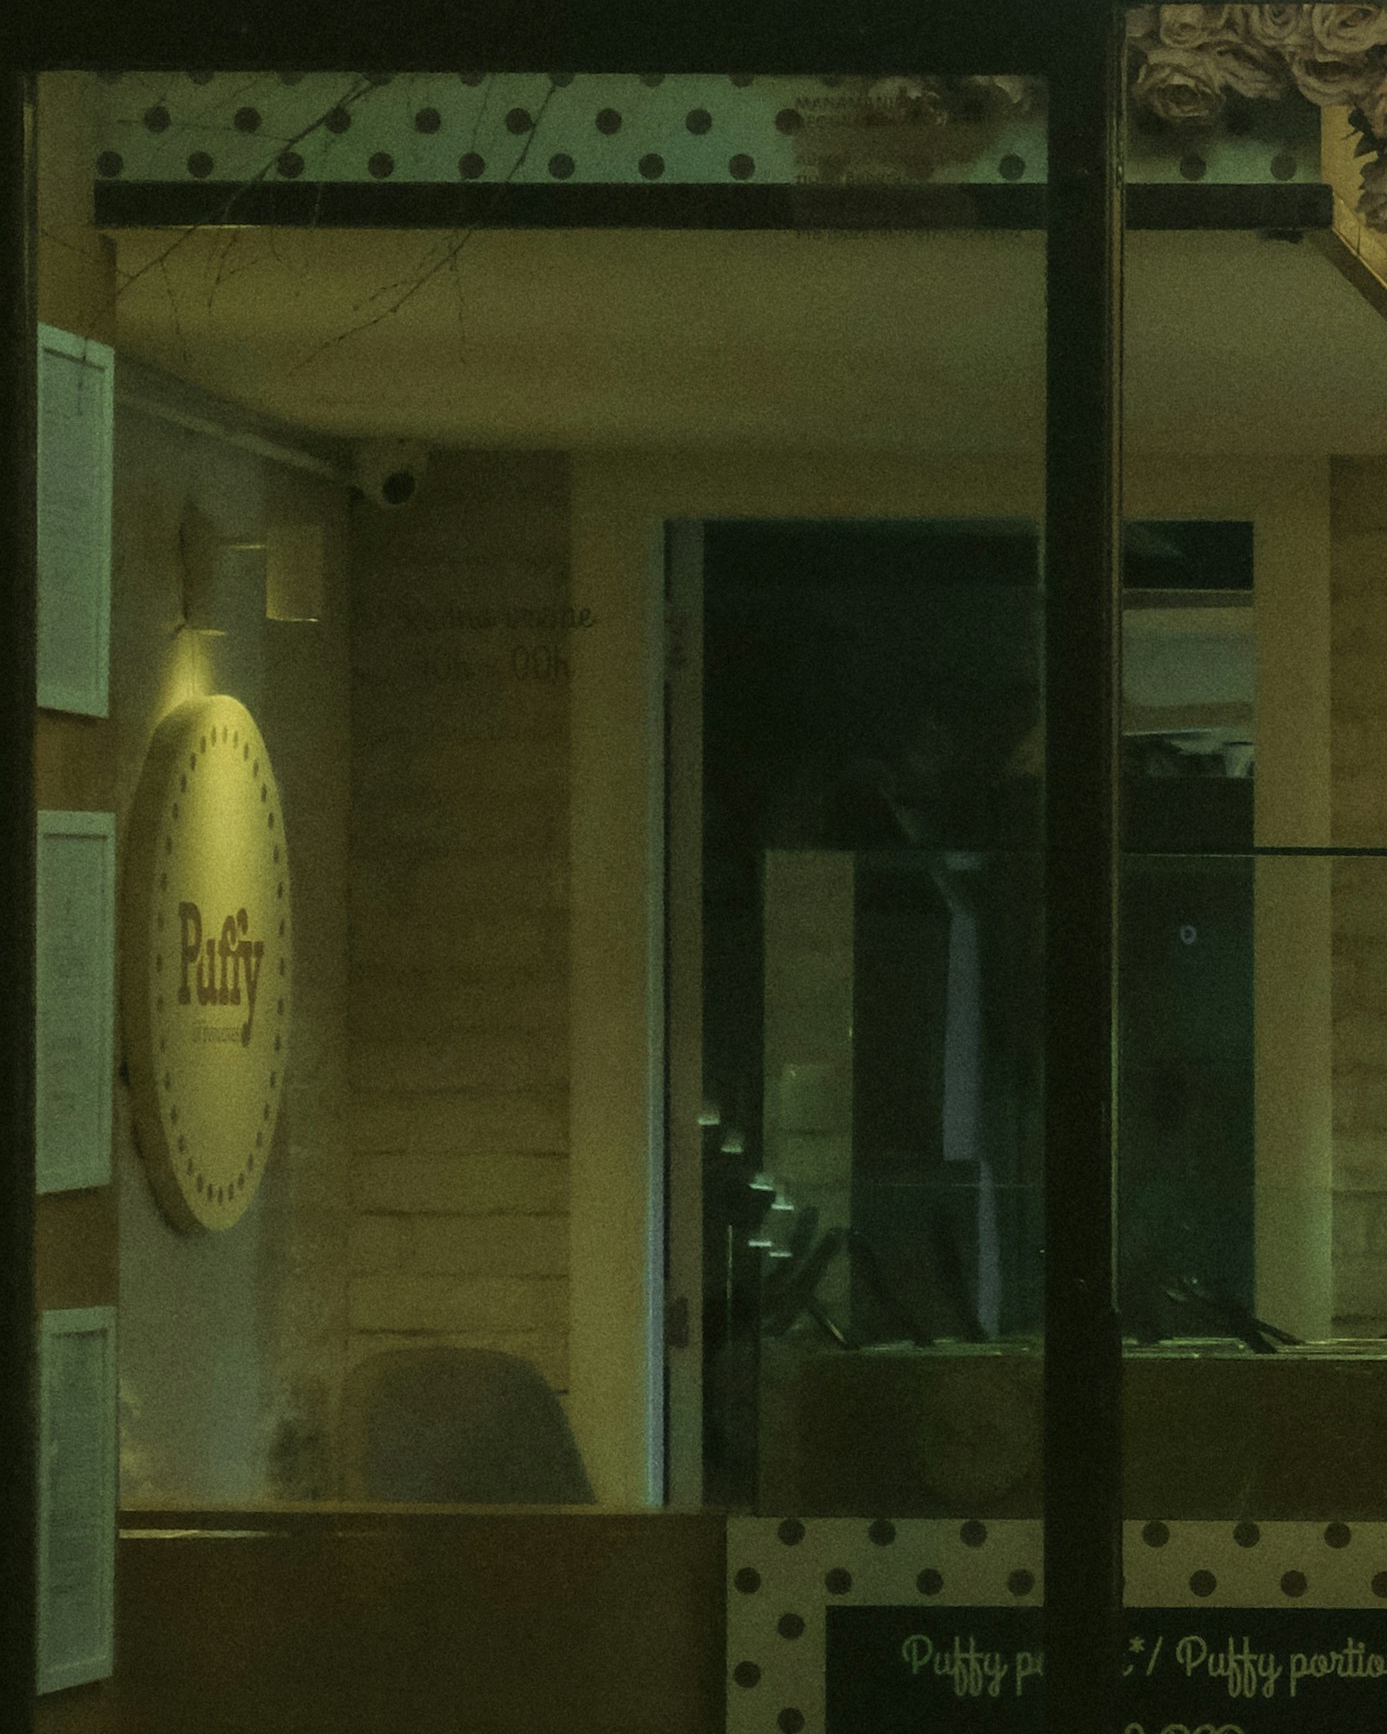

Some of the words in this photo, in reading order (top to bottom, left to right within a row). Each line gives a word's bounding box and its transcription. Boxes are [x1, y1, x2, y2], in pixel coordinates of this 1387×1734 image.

[177, 901, 264, 1048] Puffy
[901, 1633, 1009, 1699] Puffy
[1175, 1634, 1282, 1699] Puffy
